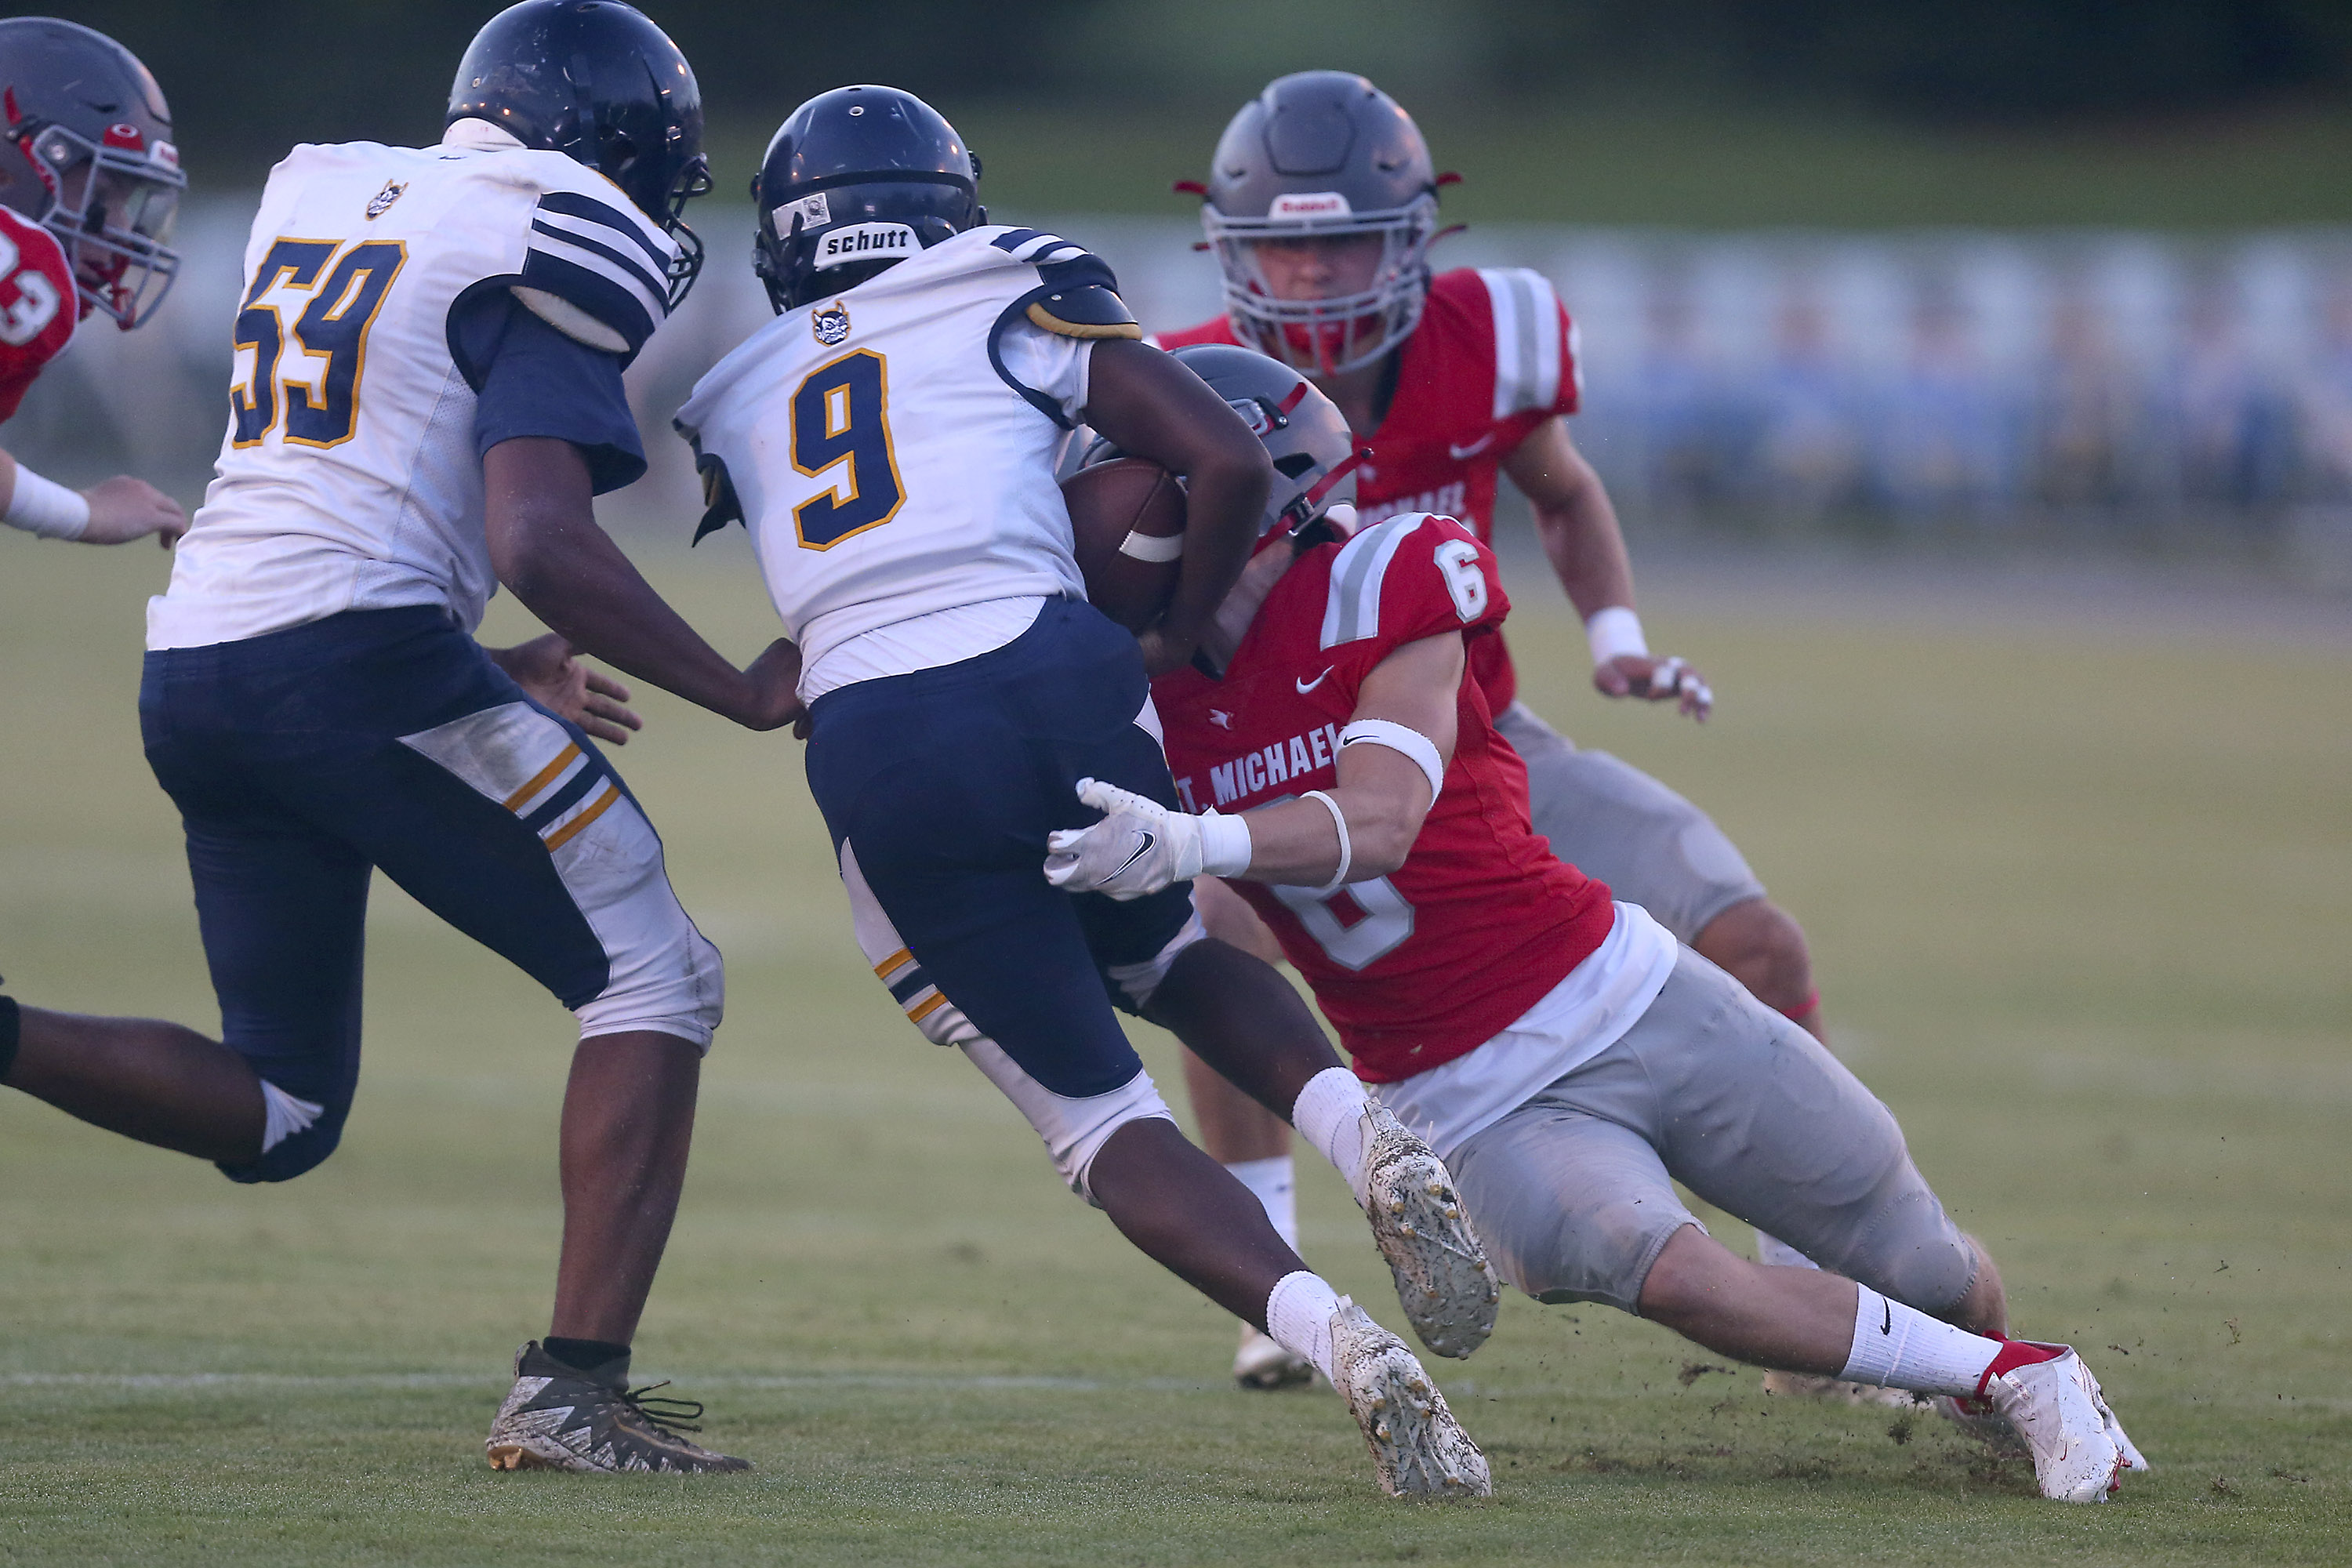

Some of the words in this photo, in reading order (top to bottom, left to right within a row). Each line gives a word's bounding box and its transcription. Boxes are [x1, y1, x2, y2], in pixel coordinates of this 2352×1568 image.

[827, 230, 908, 255] schutt
[230, 236, 409, 450] 59
[789, 347, 908, 552] 9
[1433, 539, 1488, 624] 6
[1177, 776, 1209, 814] T.
